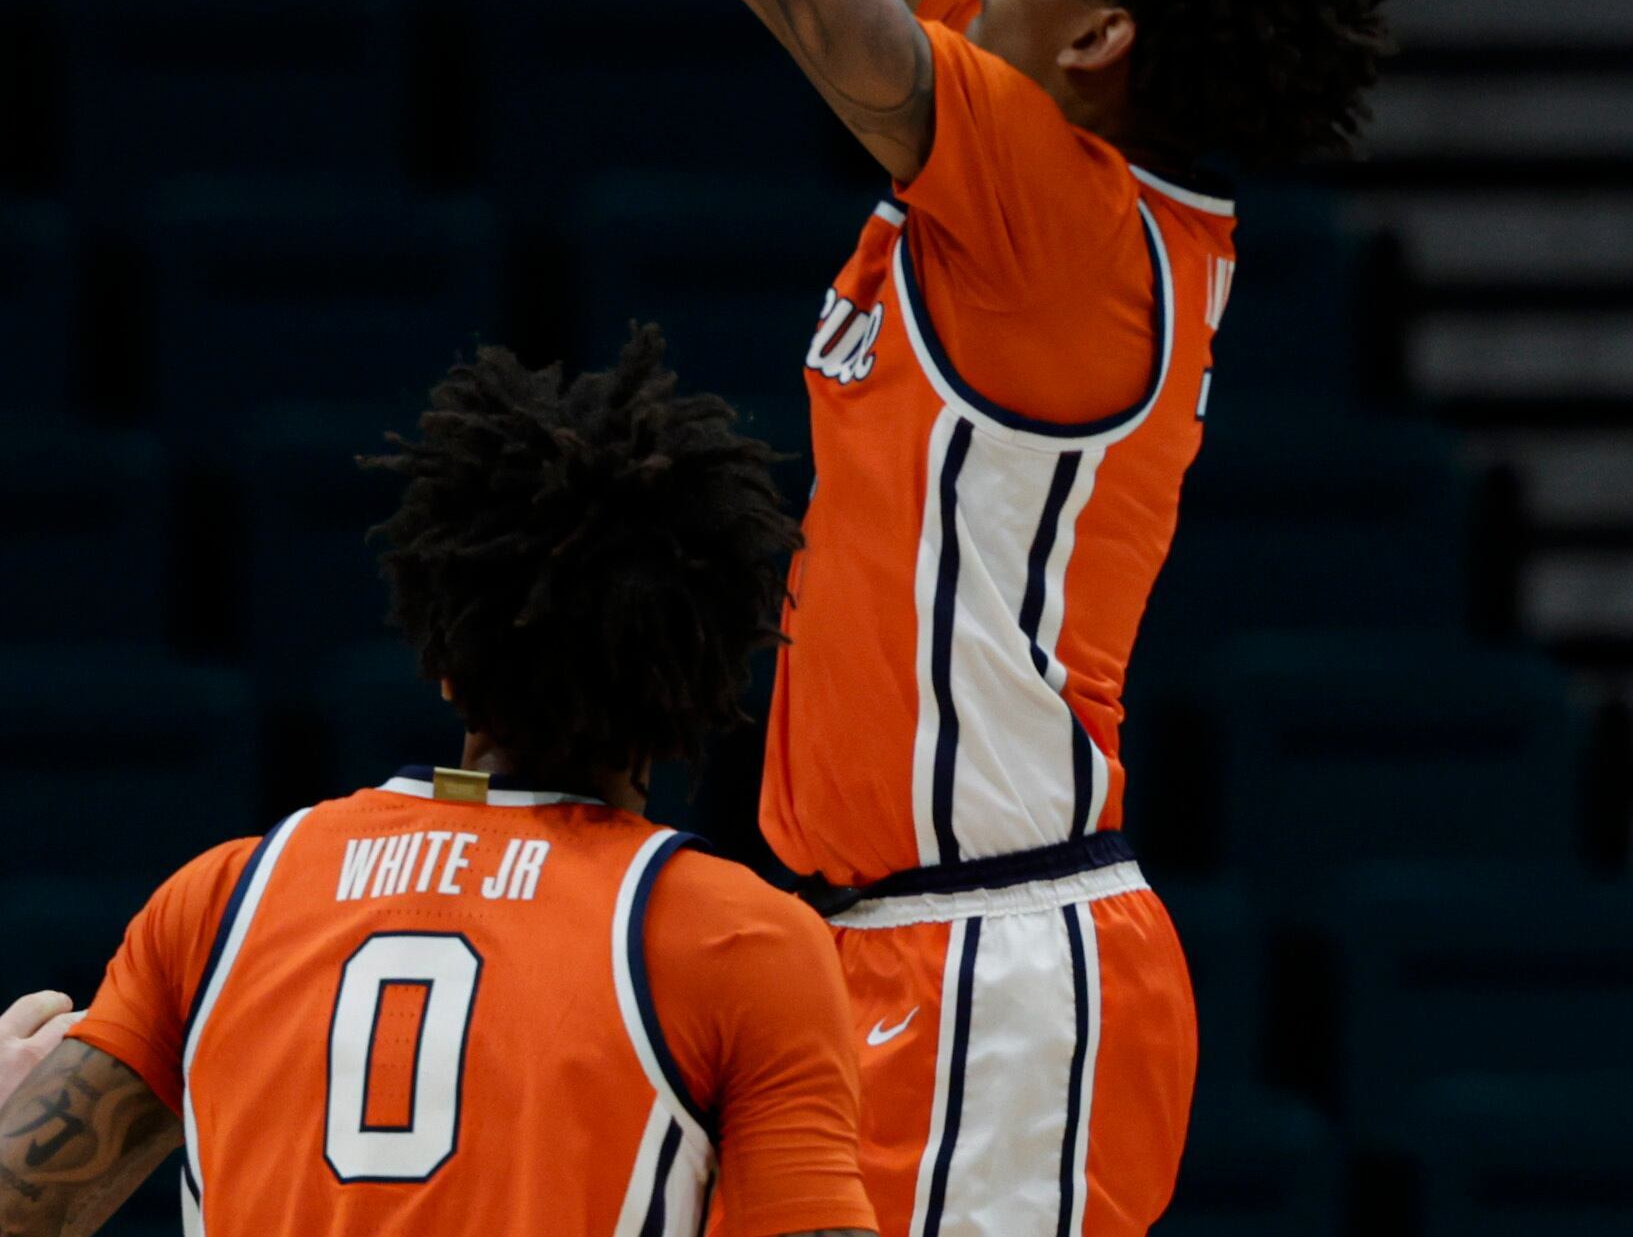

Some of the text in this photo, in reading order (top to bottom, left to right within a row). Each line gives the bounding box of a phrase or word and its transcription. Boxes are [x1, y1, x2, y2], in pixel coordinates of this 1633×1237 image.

[335, 830, 551, 902] WHITE JR
[323, 929, 486, 1185] 0
